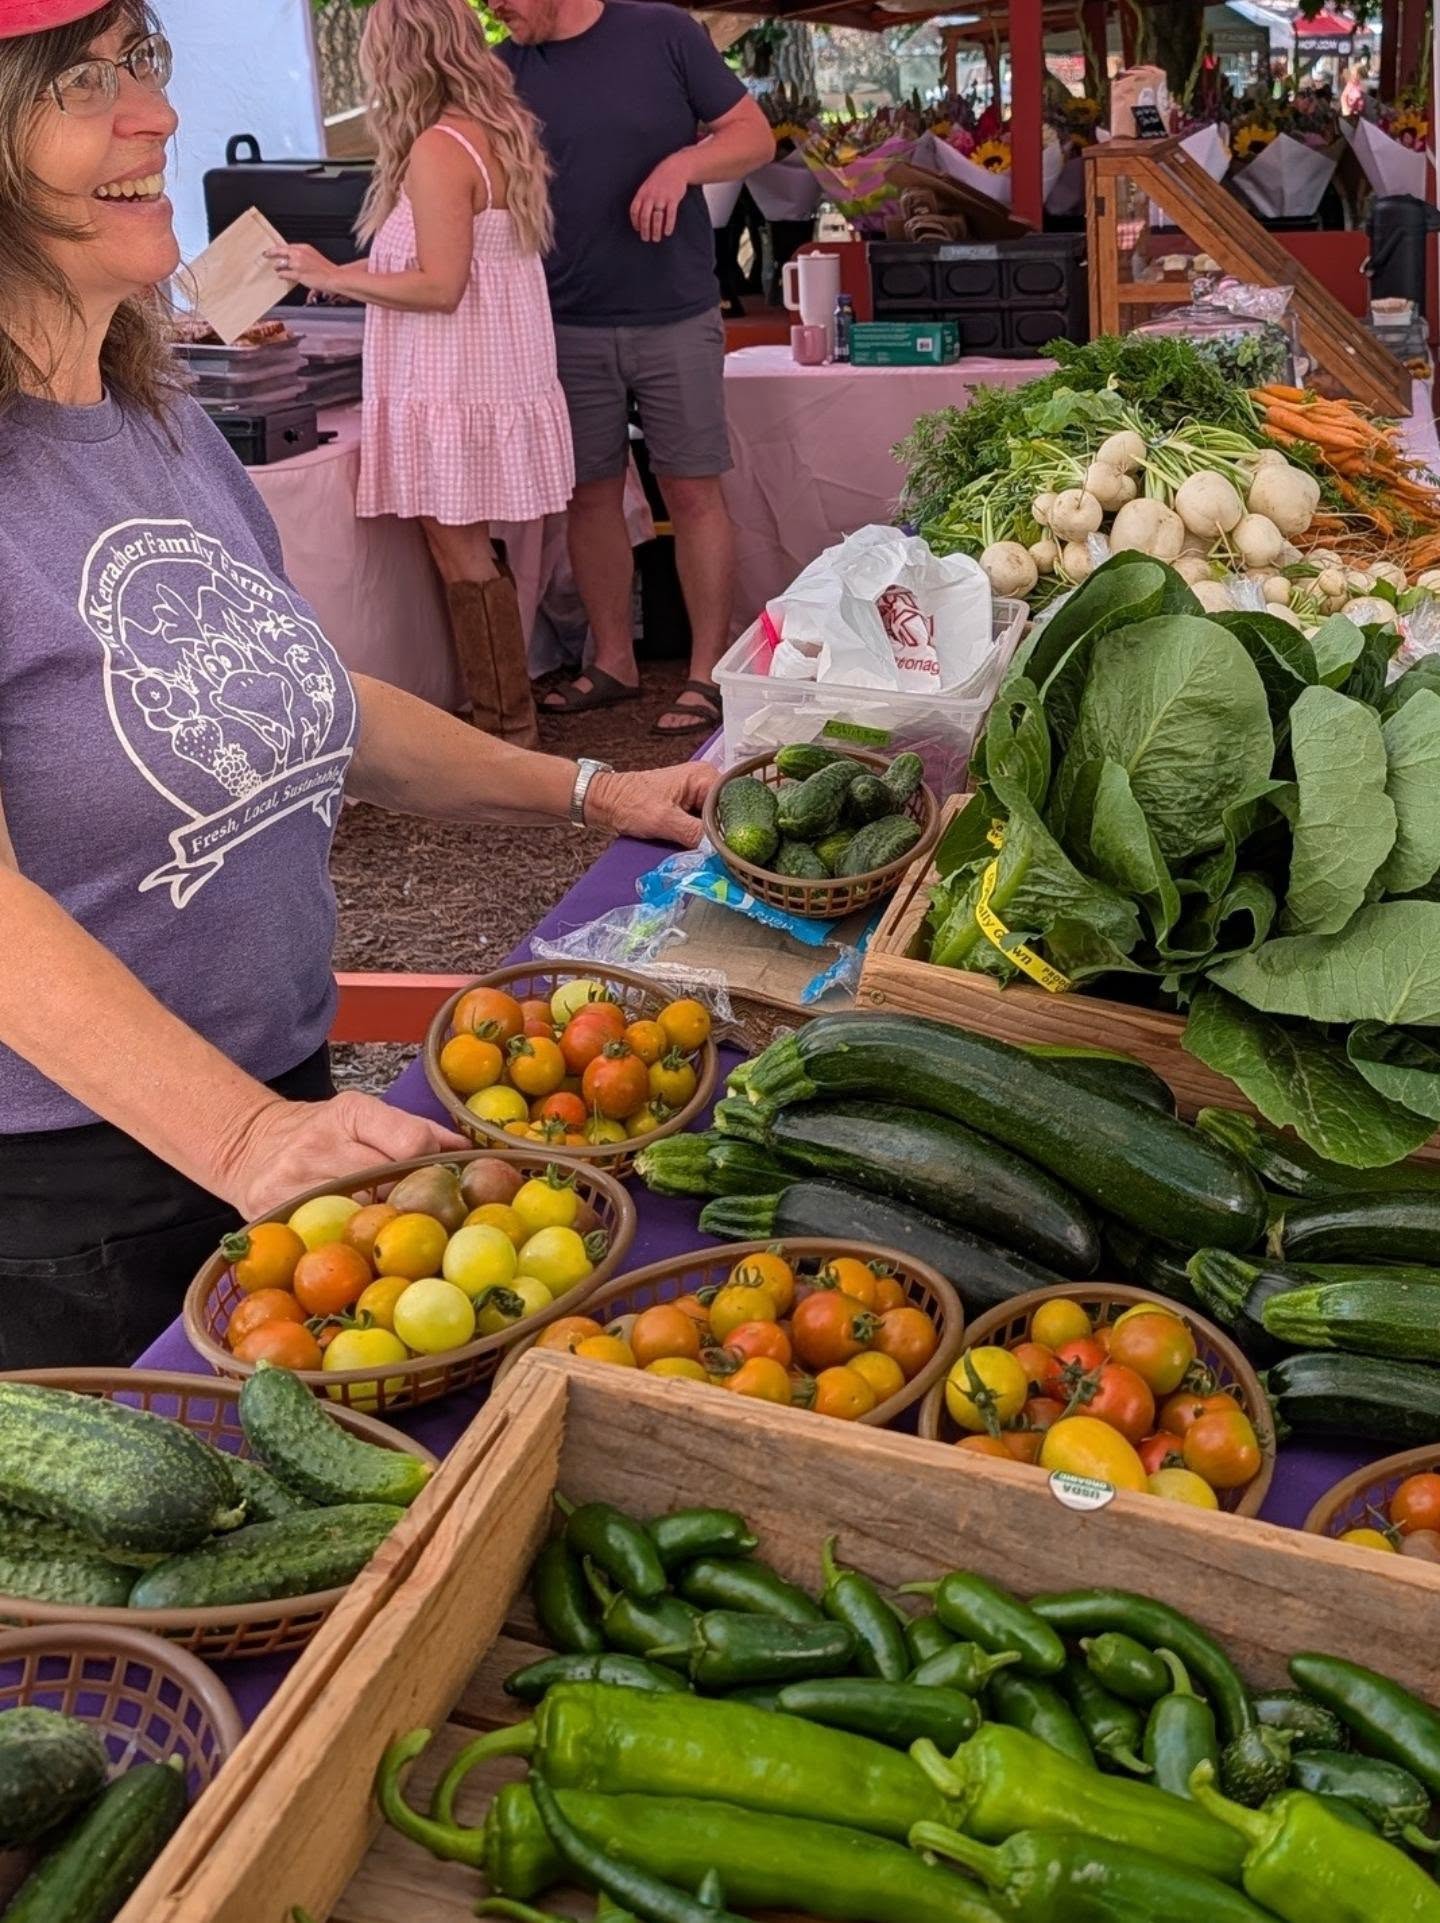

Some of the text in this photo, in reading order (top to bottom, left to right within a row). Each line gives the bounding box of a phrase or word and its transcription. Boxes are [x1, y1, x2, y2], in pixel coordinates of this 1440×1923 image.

[1297, 39, 1338, 51] HOP.COM
[144, 532, 213, 566] Family
[220, 553, 274, 602] Farm
[191, 818, 239, 855] Fresh,
[243, 791, 280, 824] Local,
[1062, 1483, 1100, 1500] USDA
